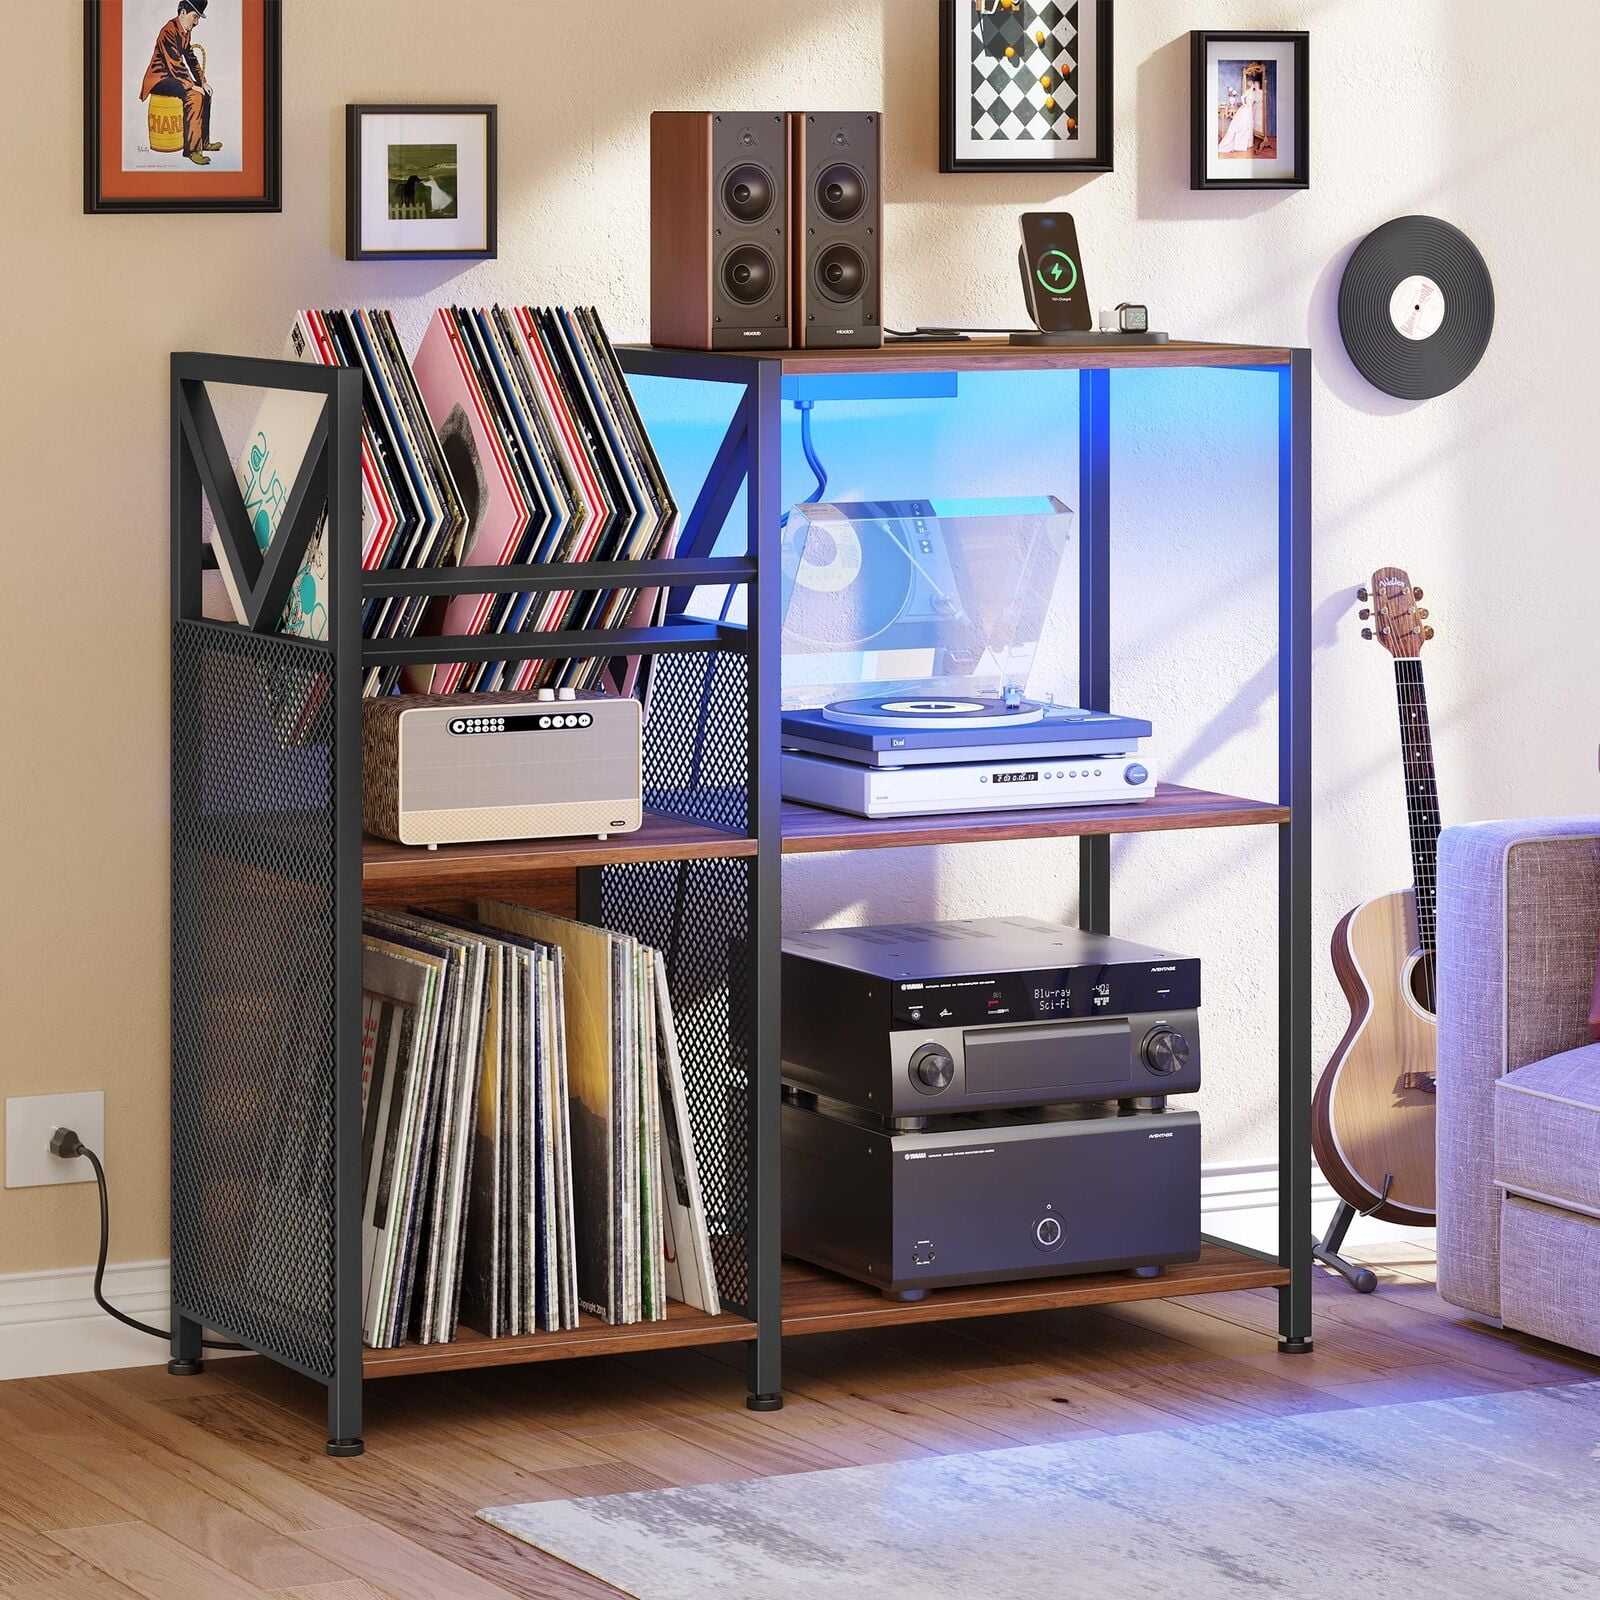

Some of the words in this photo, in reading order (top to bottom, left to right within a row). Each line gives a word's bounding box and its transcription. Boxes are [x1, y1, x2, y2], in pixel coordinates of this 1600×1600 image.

[893, 738, 905, 746] Dual
[1034, 988, 1071, 999] Blu-ray
[1039, 999, 1071, 1011] Sci-Fi
